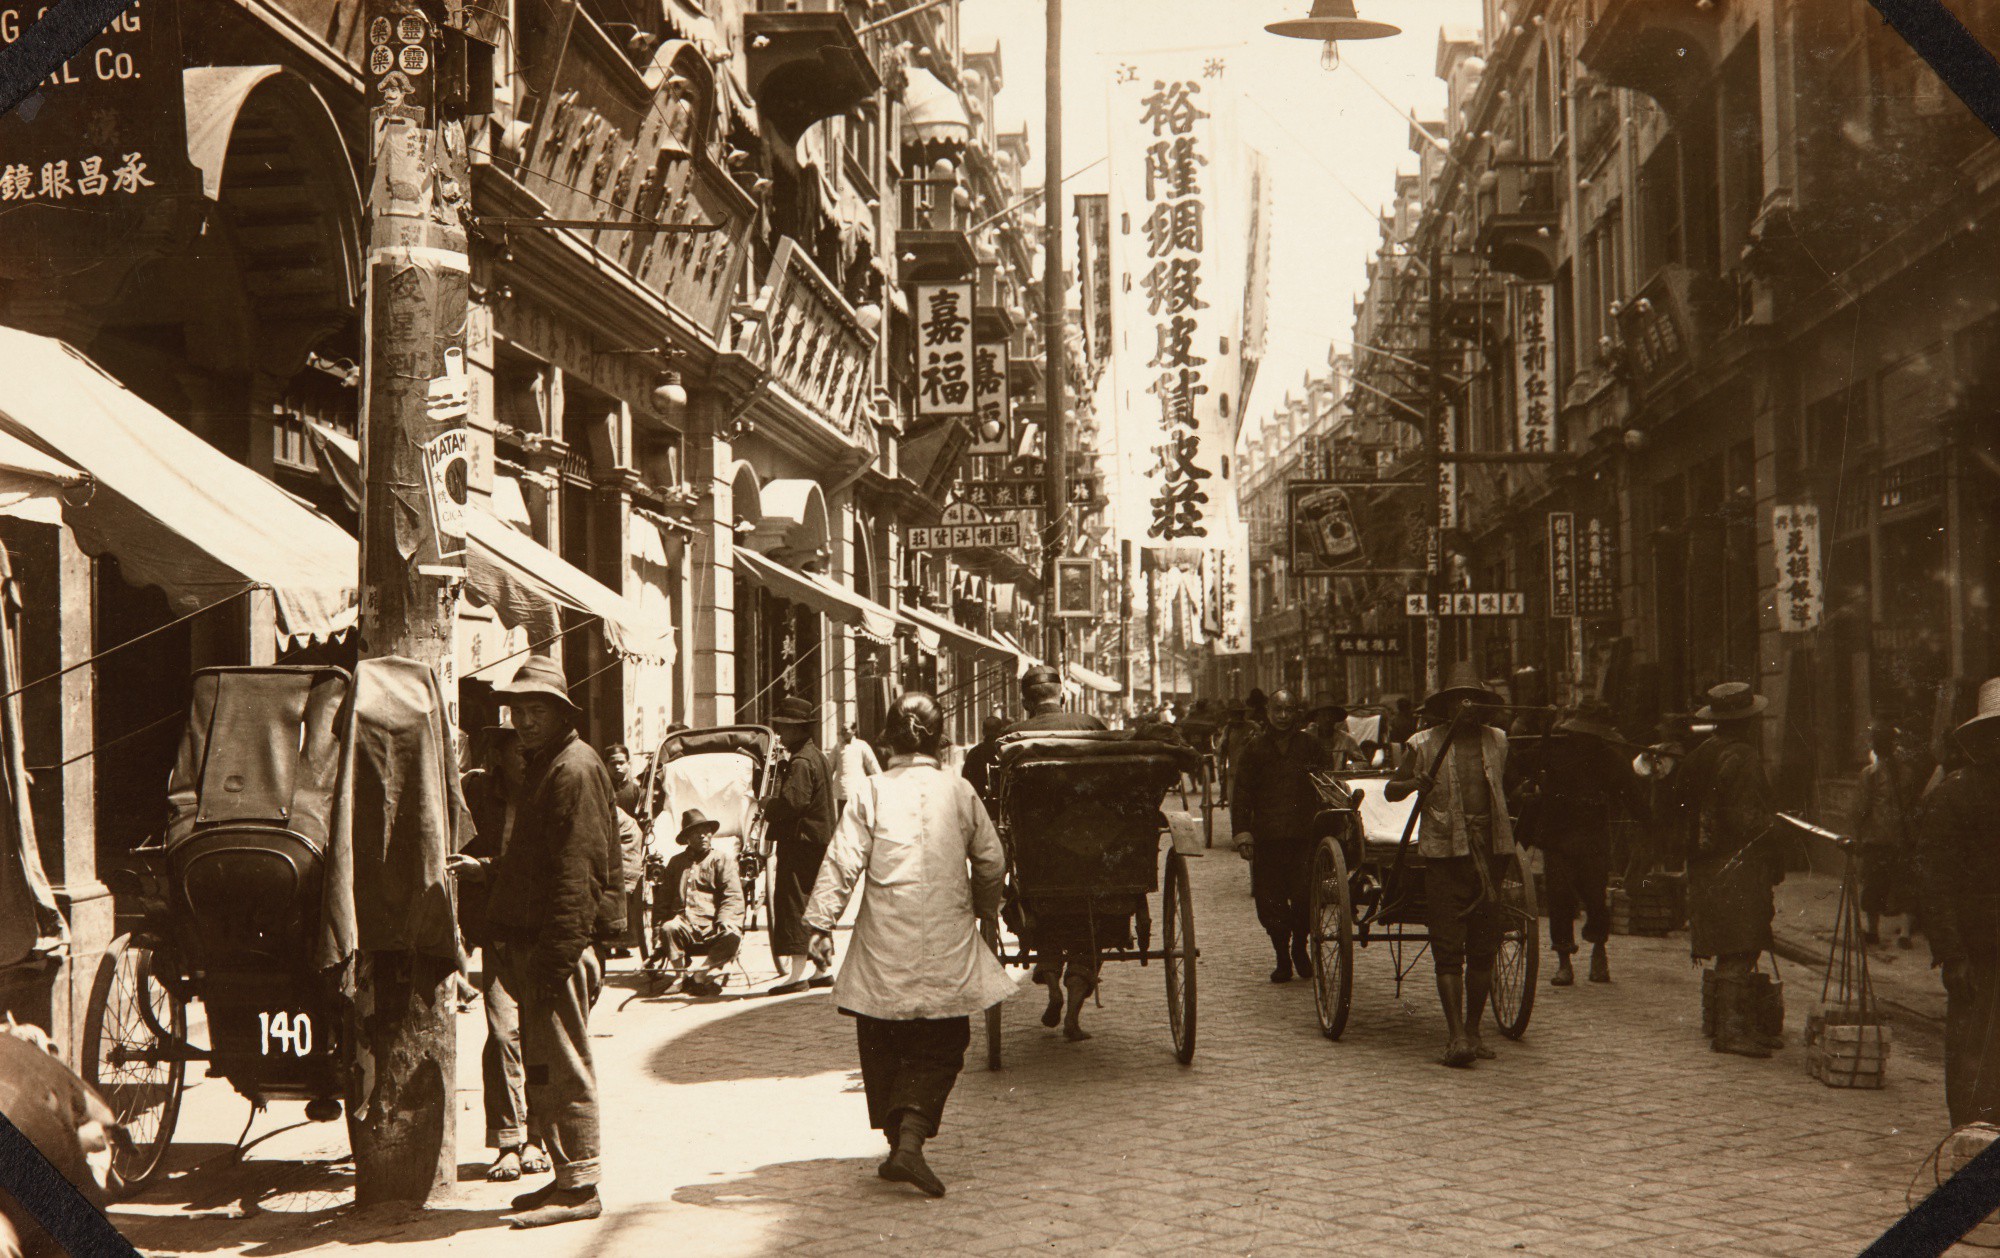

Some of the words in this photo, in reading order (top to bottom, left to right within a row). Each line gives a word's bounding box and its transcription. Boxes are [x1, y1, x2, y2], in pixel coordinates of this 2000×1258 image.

[95, 47, 141, 81] Co.
[921, 288, 970, 406] 嘉福
[259, 1011, 312, 1058] 140
